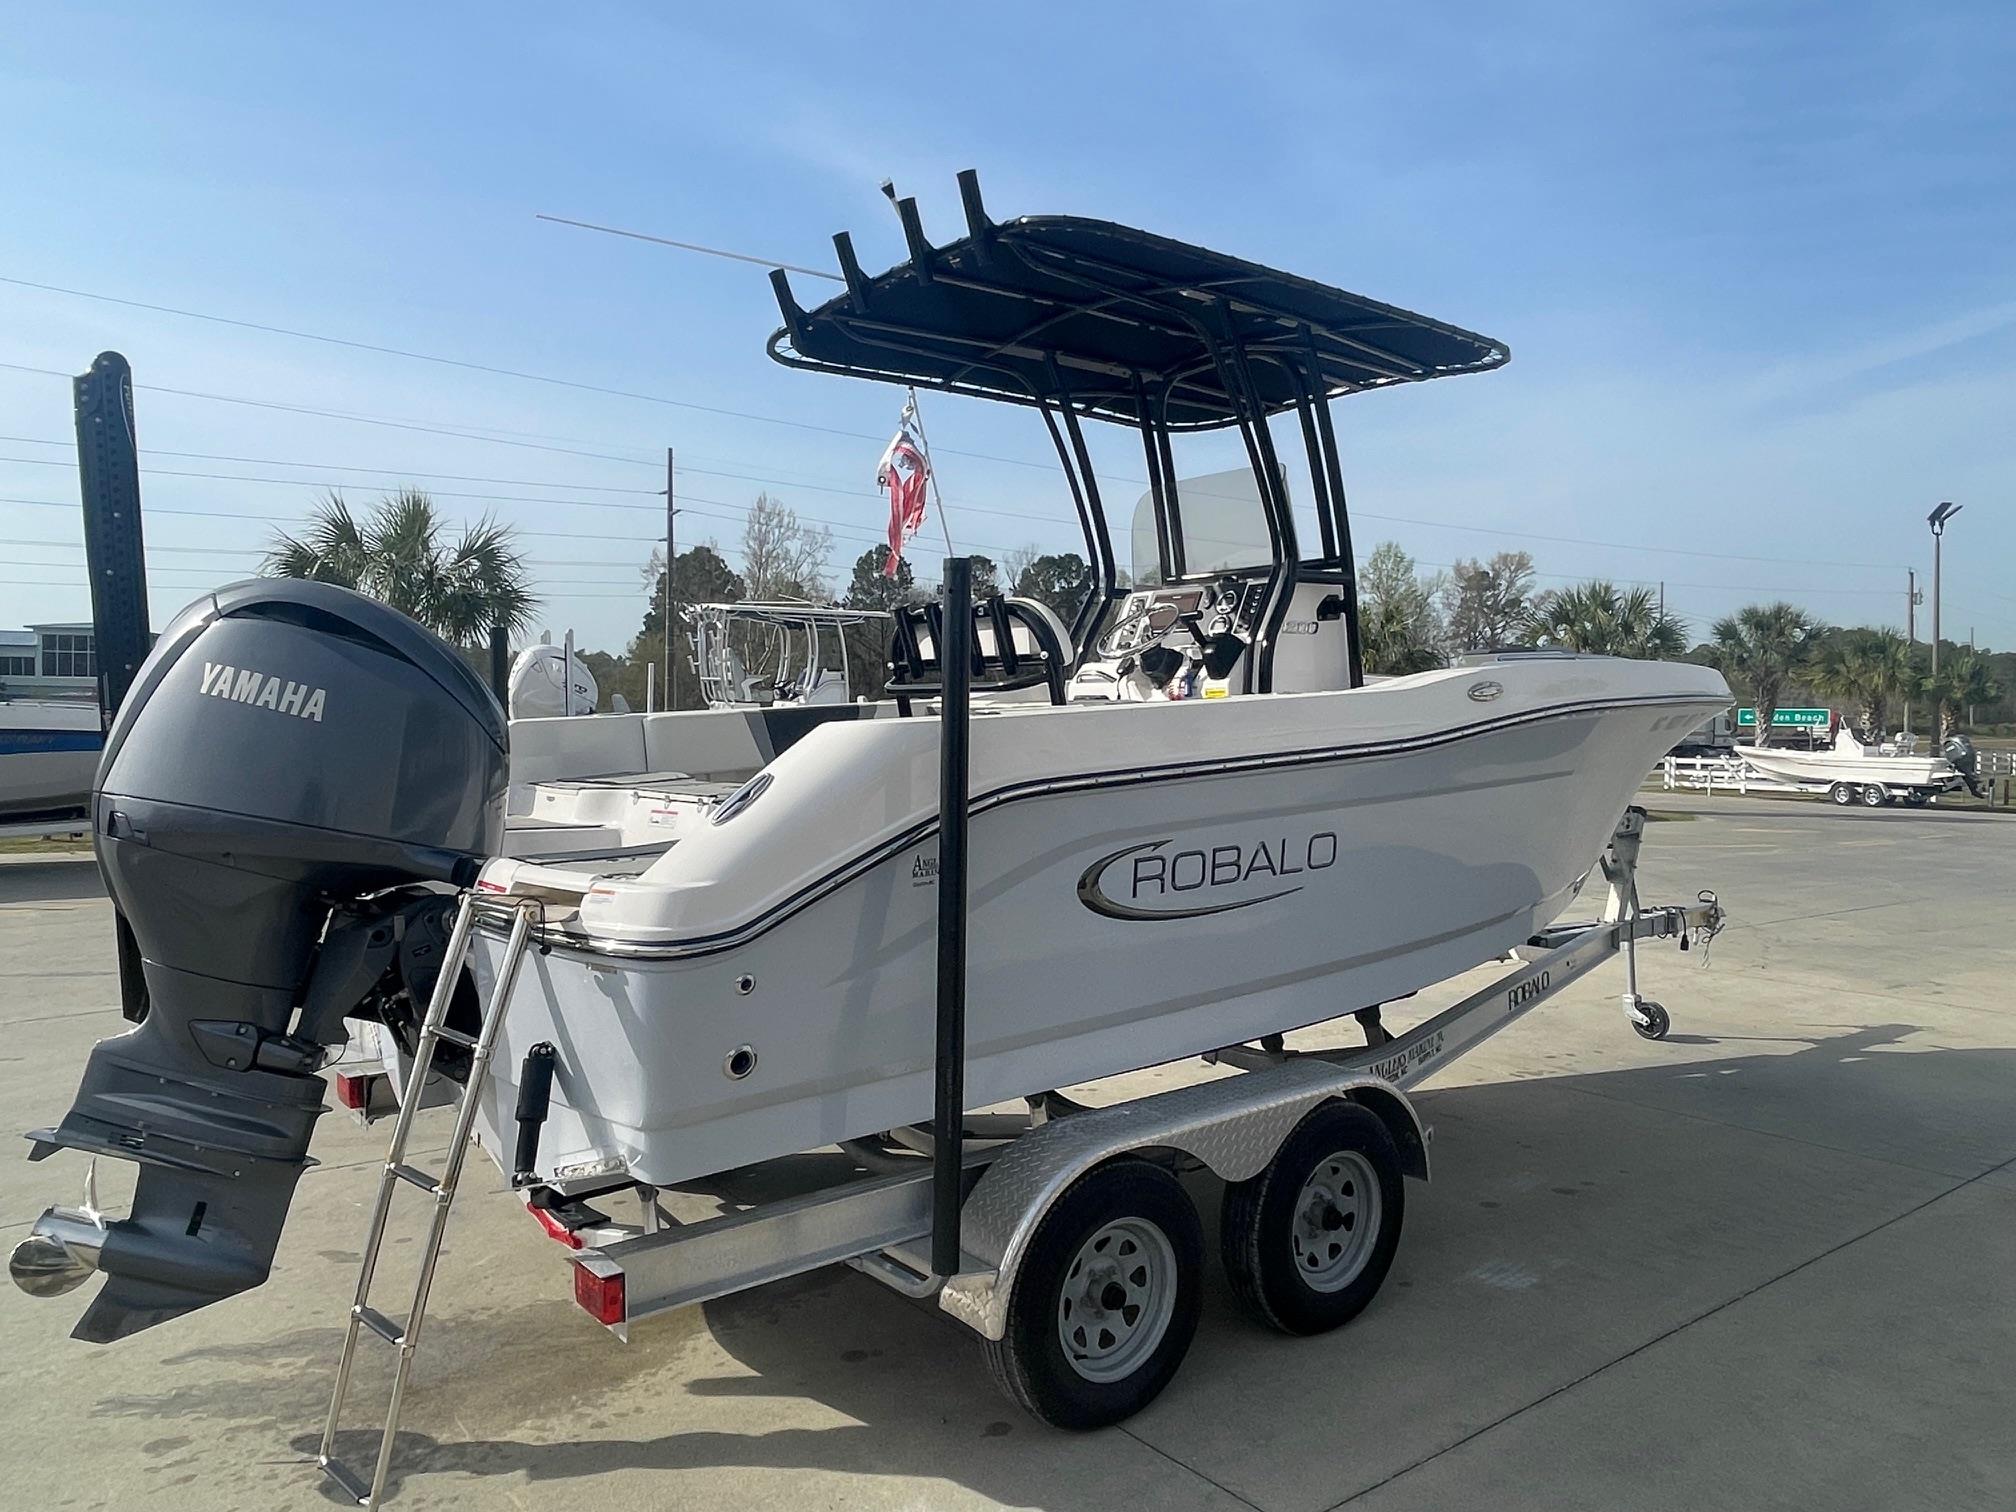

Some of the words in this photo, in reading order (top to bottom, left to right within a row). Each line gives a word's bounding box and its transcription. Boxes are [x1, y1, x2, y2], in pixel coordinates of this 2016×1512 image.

[200, 662, 327, 722] YAMAHA
[1794, 713, 1824, 723] Beach
[1131, 831, 1338, 898] ROBALO
[1508, 970, 1550, 1011] ROBALO
